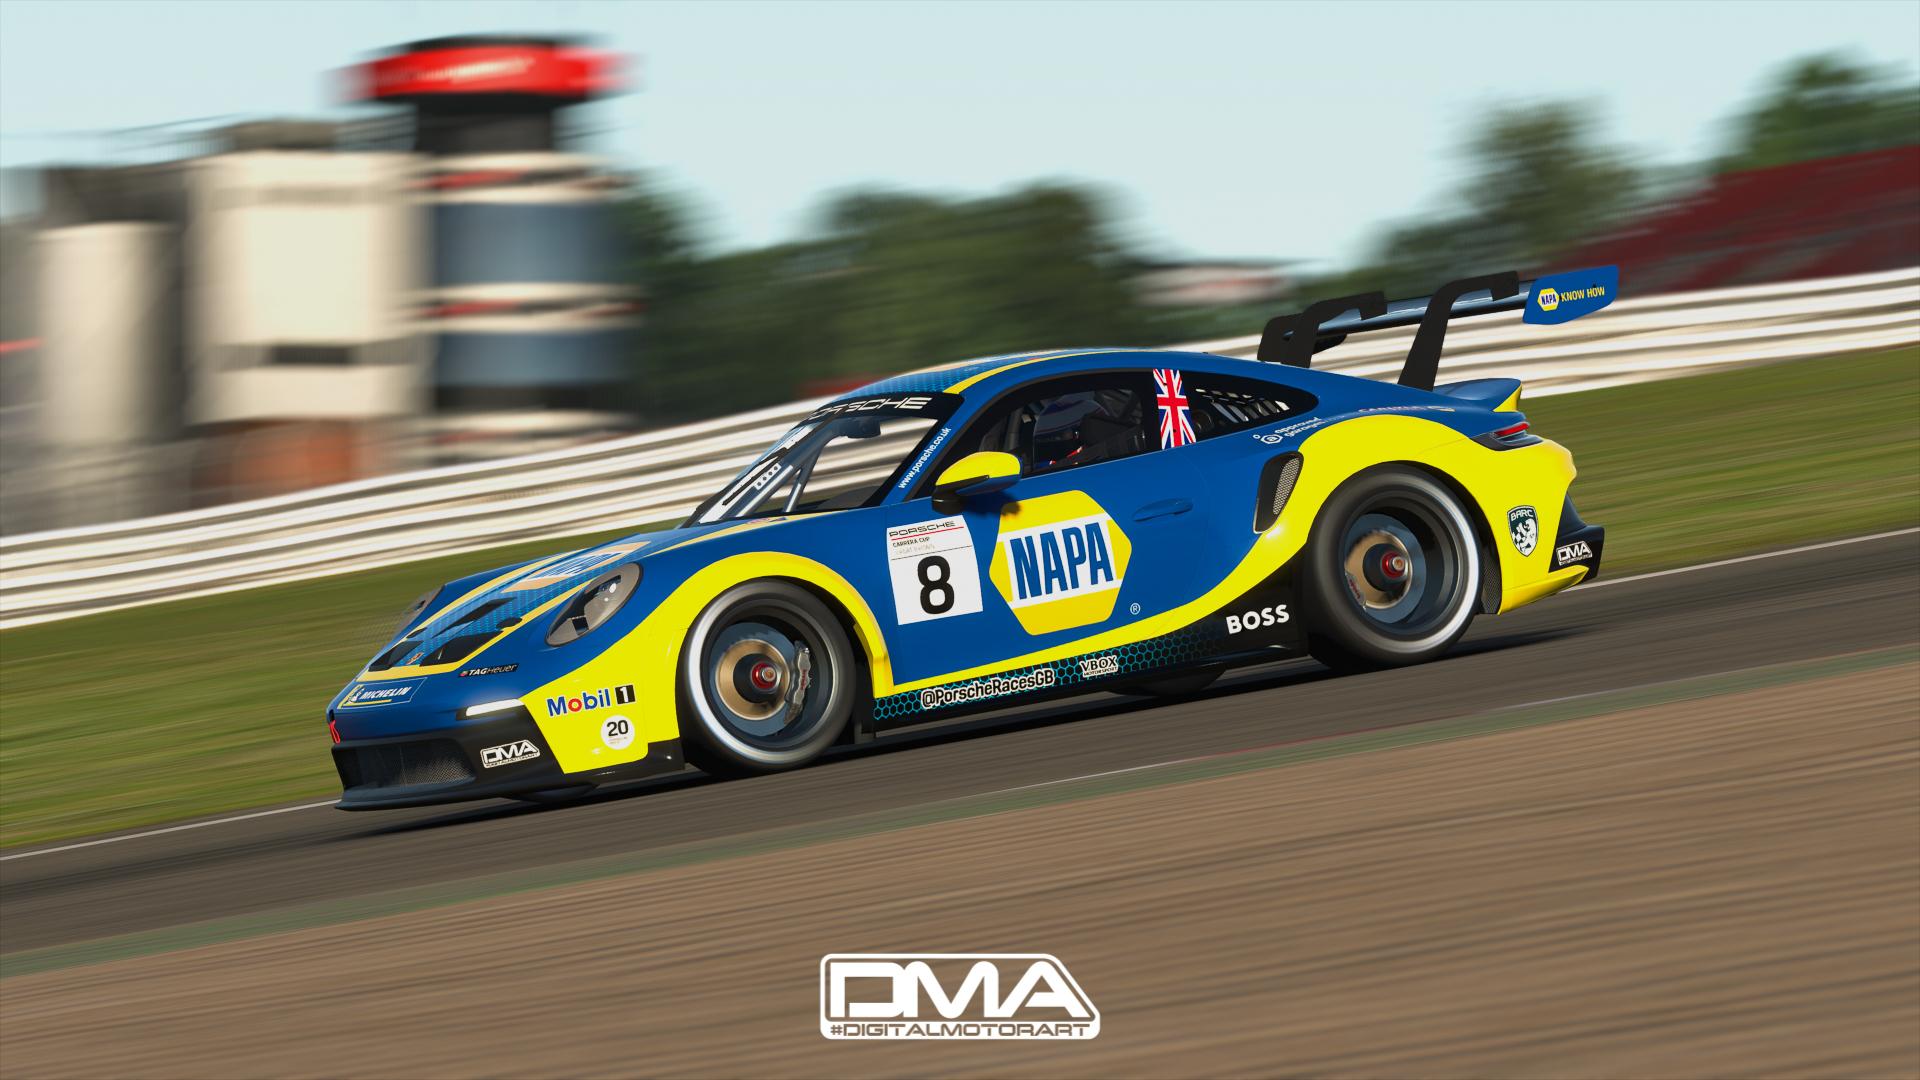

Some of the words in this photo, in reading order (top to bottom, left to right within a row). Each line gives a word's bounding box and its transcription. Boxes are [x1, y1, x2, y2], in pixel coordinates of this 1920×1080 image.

[1541, 293, 1557, 305] NAPA
[1560, 289, 1585, 302] KNOW
[1587, 286, 1605, 298] HOW
[898, 428, 951, 489] www.porsche.co.uk
[1510, 509, 1534, 521] BARC
[889, 521, 955, 536] PORSCHE
[892, 539, 918, 548] CARRERA
[1558, 543, 1590, 561] DMA
[1010, 522, 1114, 600] NAPA
[917, 555, 955, 615] 8
[1226, 604, 1290, 635] BOSS
[1081, 656, 1116, 671] VBOX
[360, 687, 412, 699] MICHELIN
[922, 669, 1054, 707] @PorscheRacesGB
[547, 689, 611, 717] Mobil
[607, 720, 629, 737] 20
[483, 741, 538, 763] DMA
